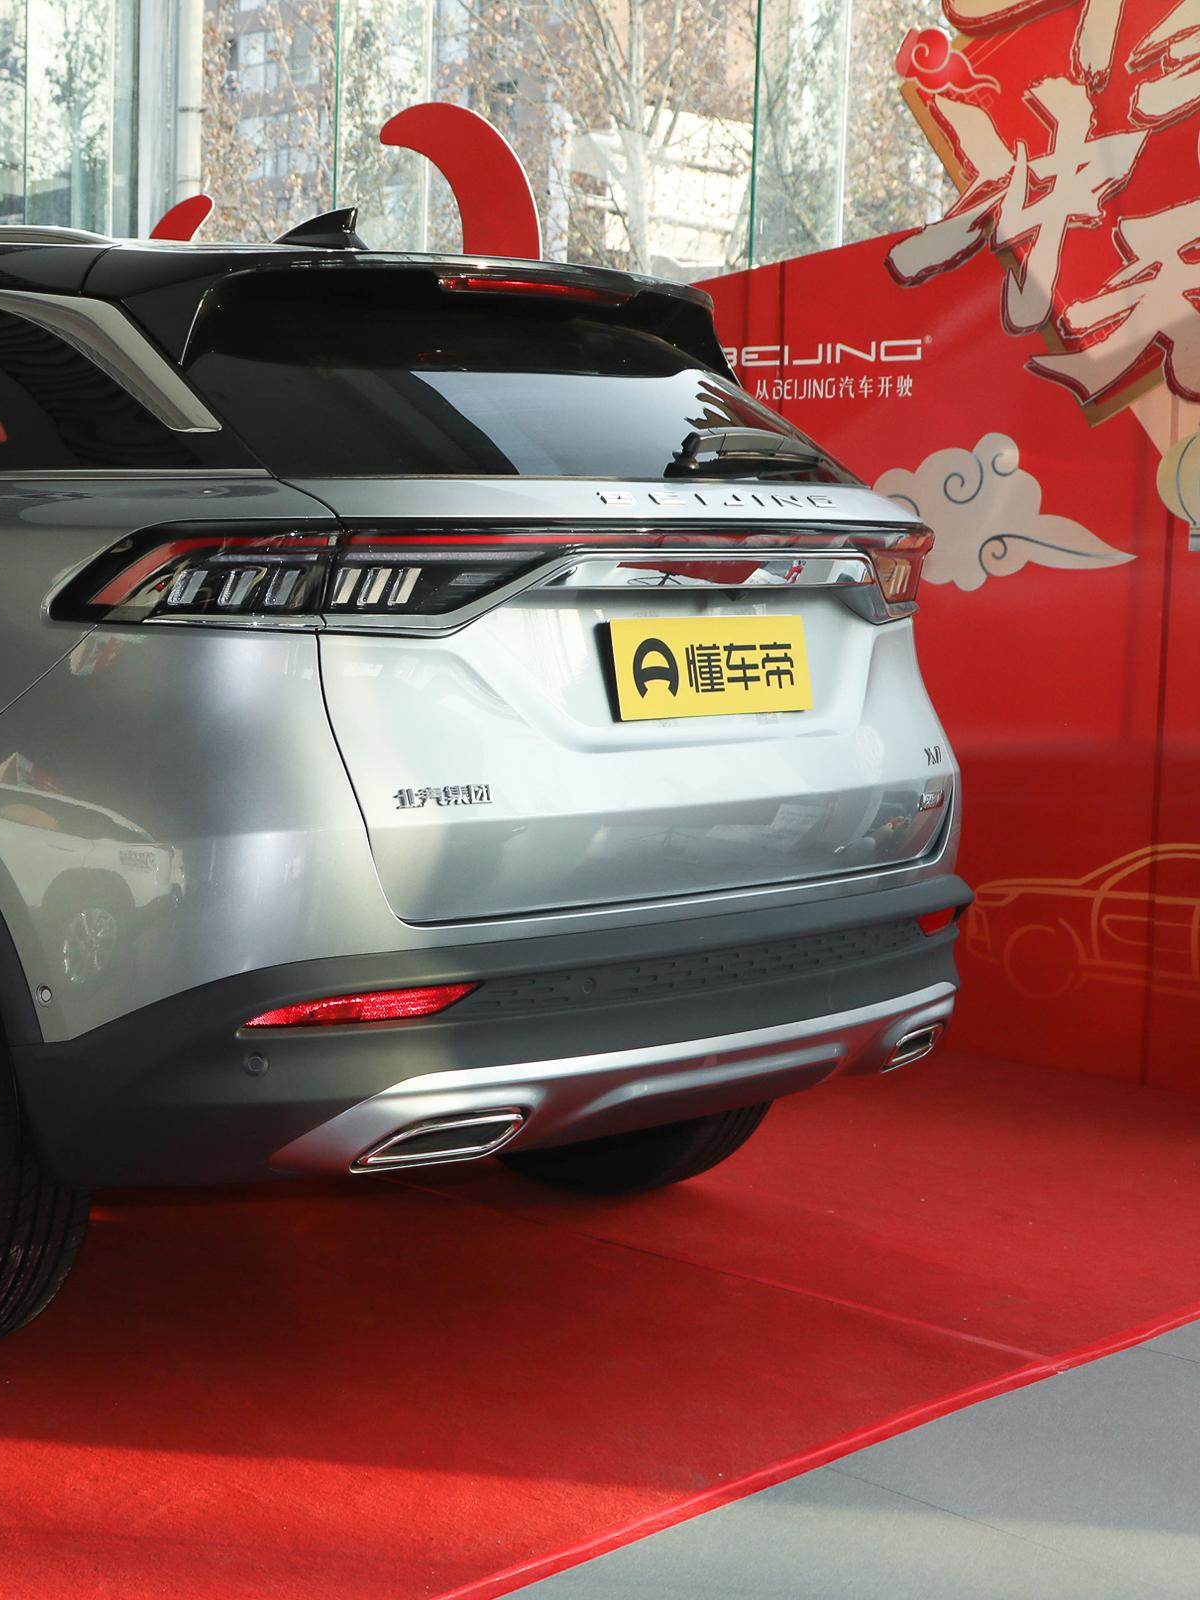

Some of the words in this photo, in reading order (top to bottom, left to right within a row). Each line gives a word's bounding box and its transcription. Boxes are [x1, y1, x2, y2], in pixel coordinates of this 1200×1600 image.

[755, 374, 913, 400] 从BEIJING汽车开驶
[596, 490, 837, 508] BEIJING
[685, 641, 794, 693] 懂车帝
[392, 783, 493, 810] 北汽集团
